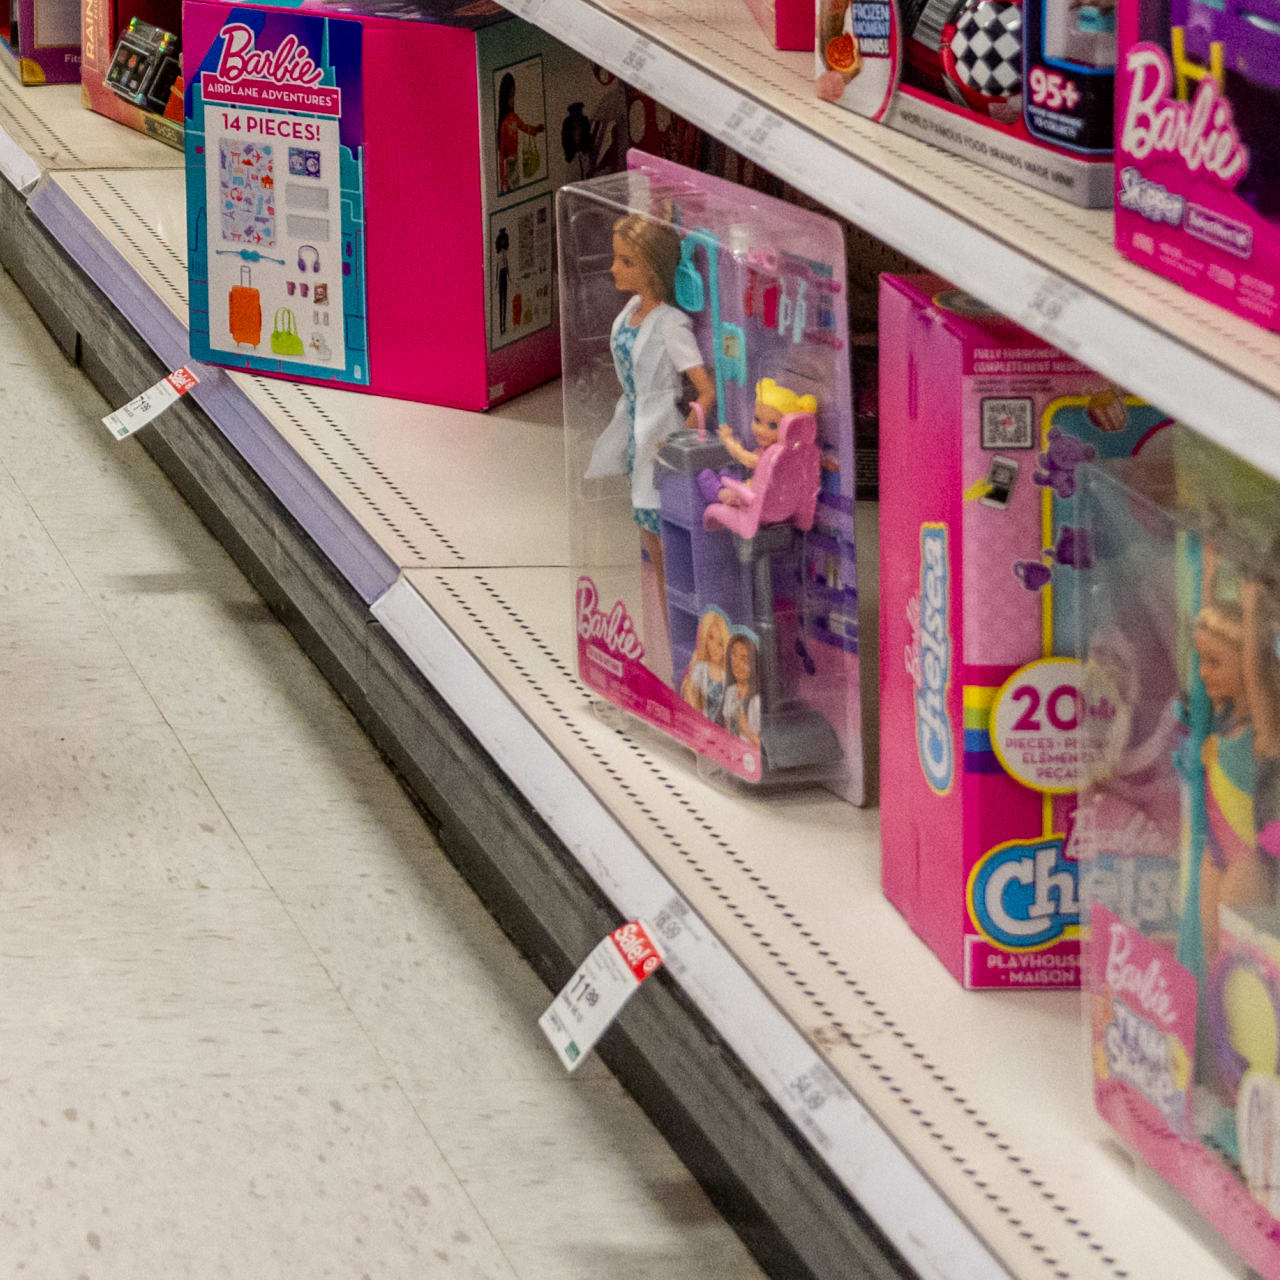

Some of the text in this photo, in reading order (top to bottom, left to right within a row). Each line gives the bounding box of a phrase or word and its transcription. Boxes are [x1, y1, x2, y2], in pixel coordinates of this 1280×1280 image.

[852, 3, 890, 22] FROZEN
[852, 19, 890, 37] MOMENT
[219, 24, 322, 85] Barbie
[859, 38, 889, 56] MINIS!
[207, 81, 259, 100] AIRPLANE
[1027, 67, 1082, 110] 95+
[221, 113, 322, 142] 14 PIECES!
[1120, 50, 1246, 181] Barbie
[576, 582, 645, 660] Barbie
[918, 536, 950, 782] Chelsea
[613, 923, 649, 967] Sale!
